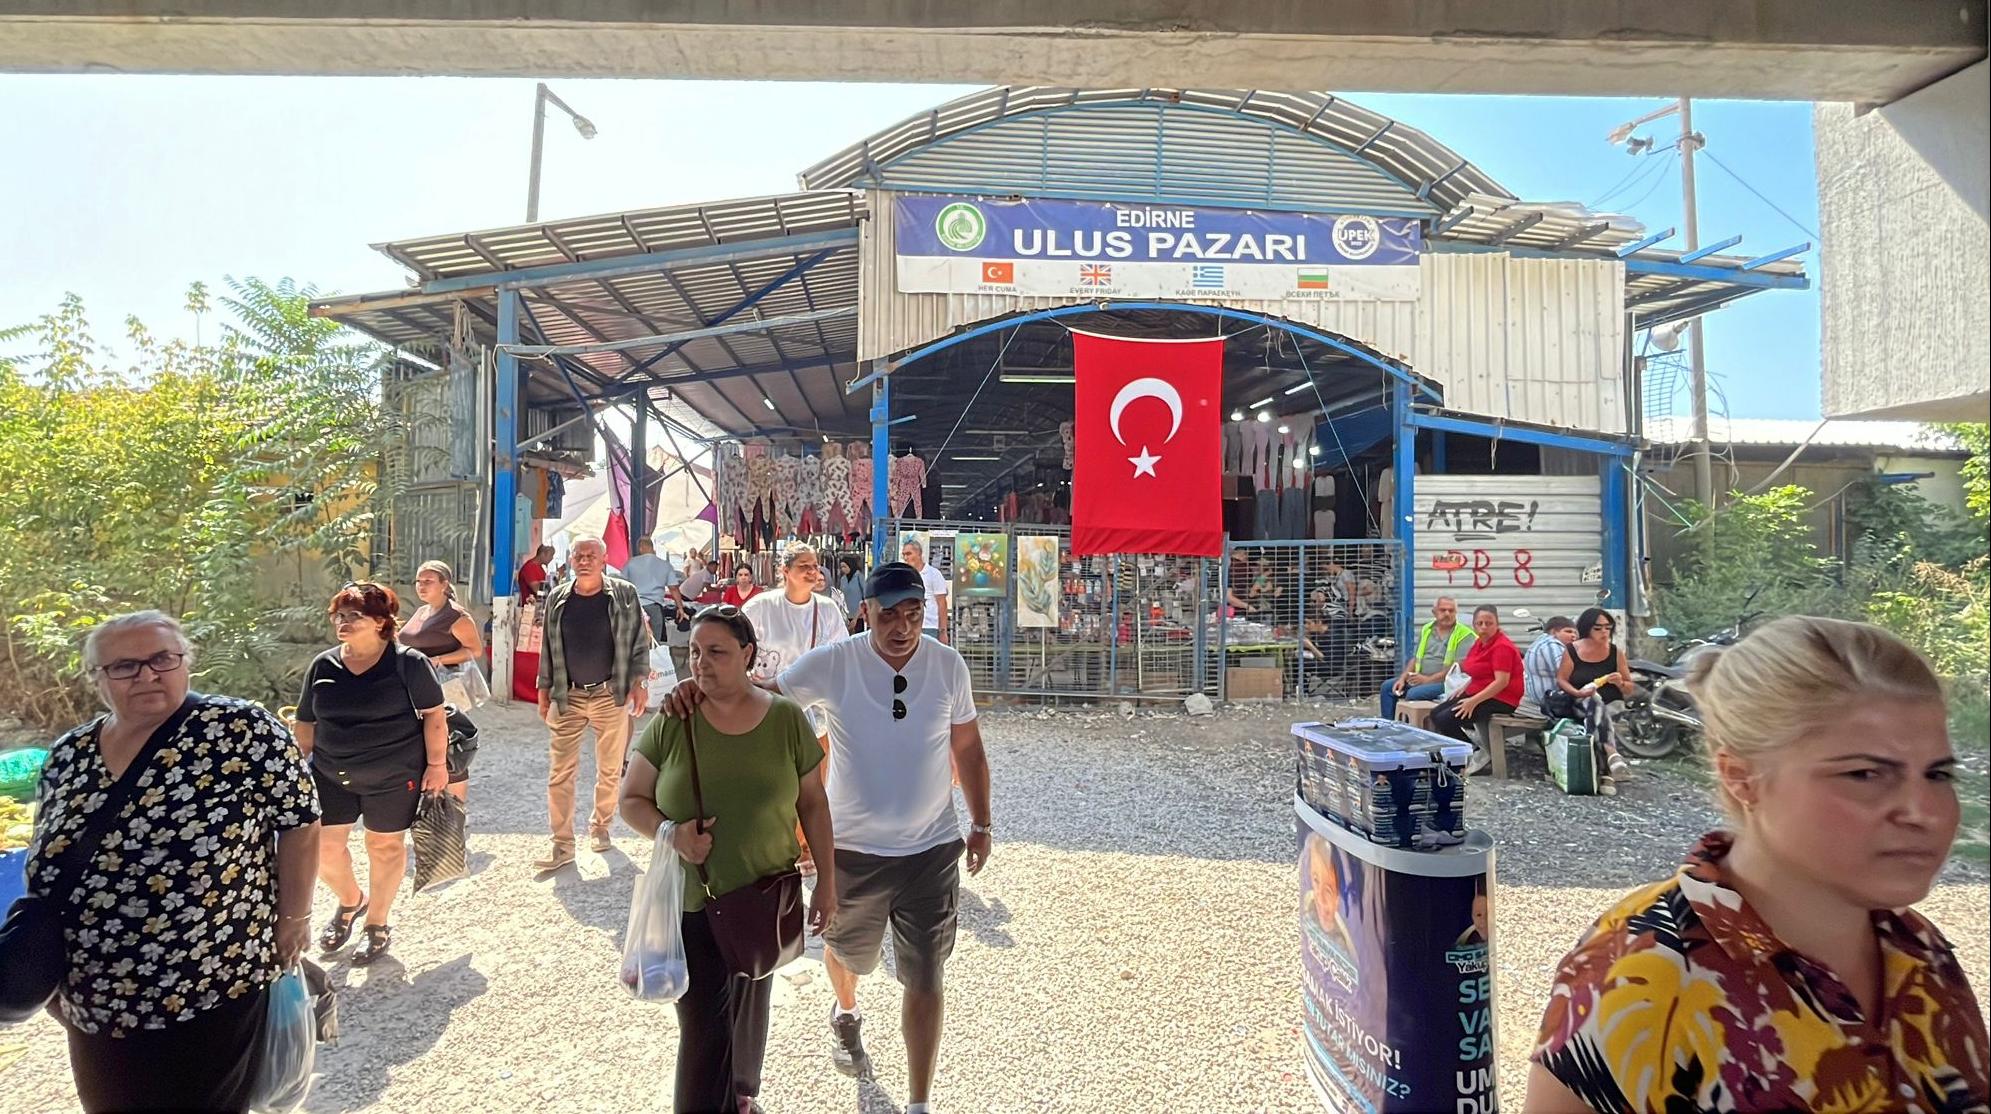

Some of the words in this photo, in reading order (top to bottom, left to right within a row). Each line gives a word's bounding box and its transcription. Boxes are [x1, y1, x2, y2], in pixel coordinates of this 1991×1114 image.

[1116, 207, 1194, 230] EDİRNE
[1014, 228, 1133, 258] ULUS
[1148, 232, 1306, 261] PAZARI
[1338, 229, 1372, 241] UPEK
[978, 285, 994, 293] HER
[1070, 287, 1094, 295] EVERY
[1095, 287, 1122, 295] FRIDAY
[1427, 500, 1540, 533] ATRE!
[1513, 549, 1535, 588] 8
[1458, 976, 1489, 1004] SE
[1334, 999, 1402, 1070] İSTİYOR!
[1345, 1044, 1411, 1100] MISINIZ?
